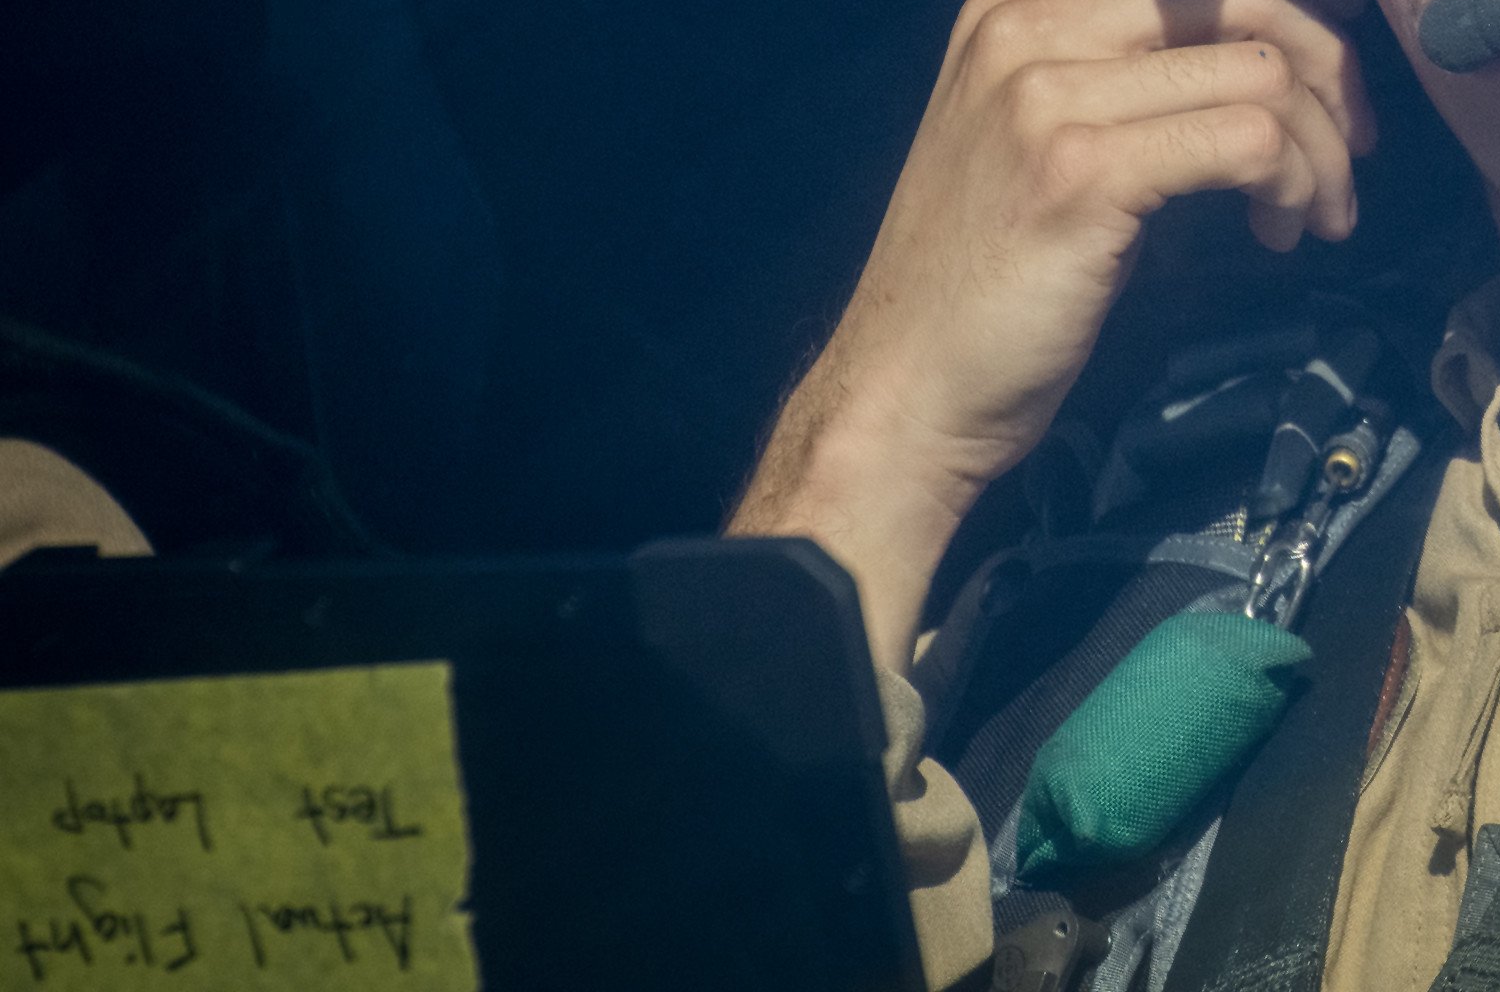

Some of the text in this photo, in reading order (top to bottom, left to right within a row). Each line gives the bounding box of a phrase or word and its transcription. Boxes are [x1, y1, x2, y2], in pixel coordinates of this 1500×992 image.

[52, 773, 423, 852] Test Laptop
[15, 874, 413, 982] Actual Flight
